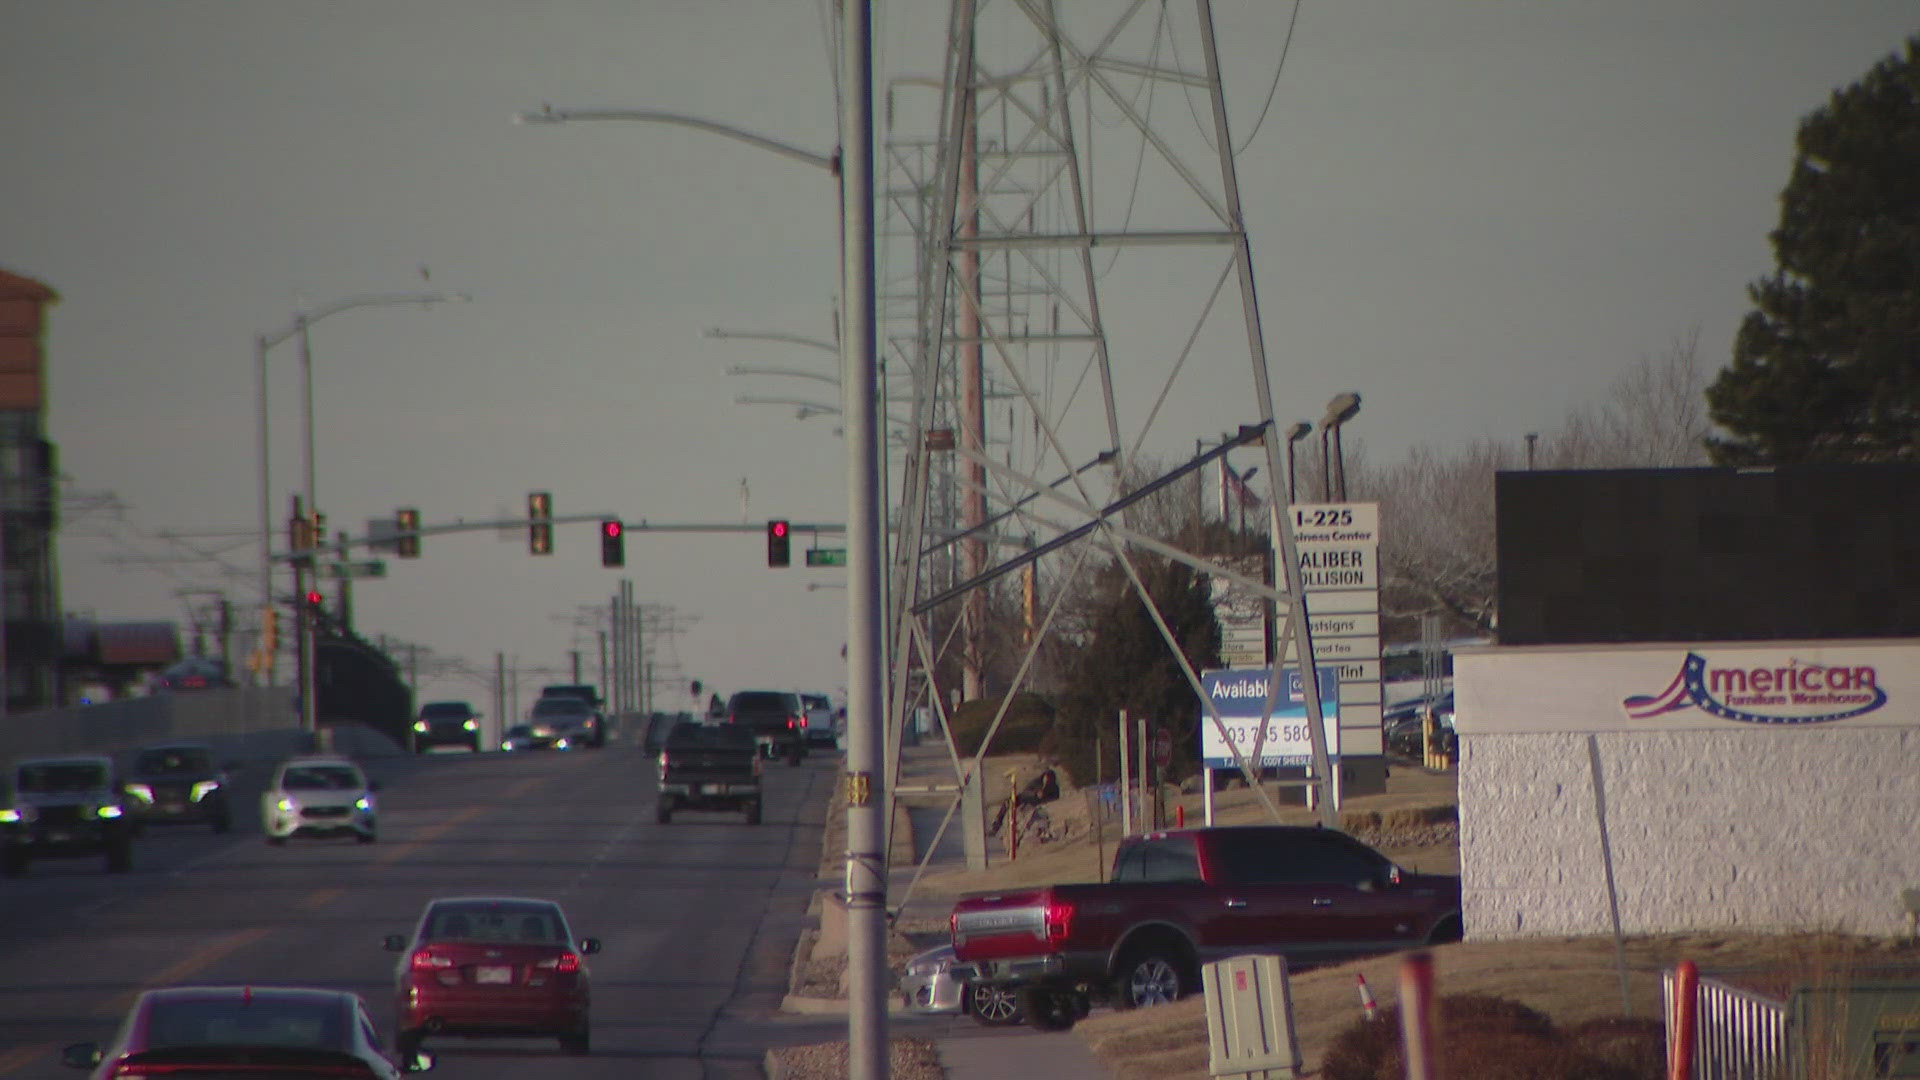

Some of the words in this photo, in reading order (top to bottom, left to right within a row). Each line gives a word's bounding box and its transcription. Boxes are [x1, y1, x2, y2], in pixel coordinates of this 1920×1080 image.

[1297, 509, 1353, 527] I-225
[1294, 532, 1330, 542] siness
[1332, 531, 1371, 541] Center
[1301, 551, 1362, 569] ALIBER
[1302, 571, 1363, 586] OLLISION
[1211, 680, 1271, 699] Availabl
[1725, 694, 1787, 705] Furniture
[1792, 693, 1872, 704] Warehouse
[1283, 725, 1311, 742] 580
[1283, 755, 1312, 765] SHEESLE
